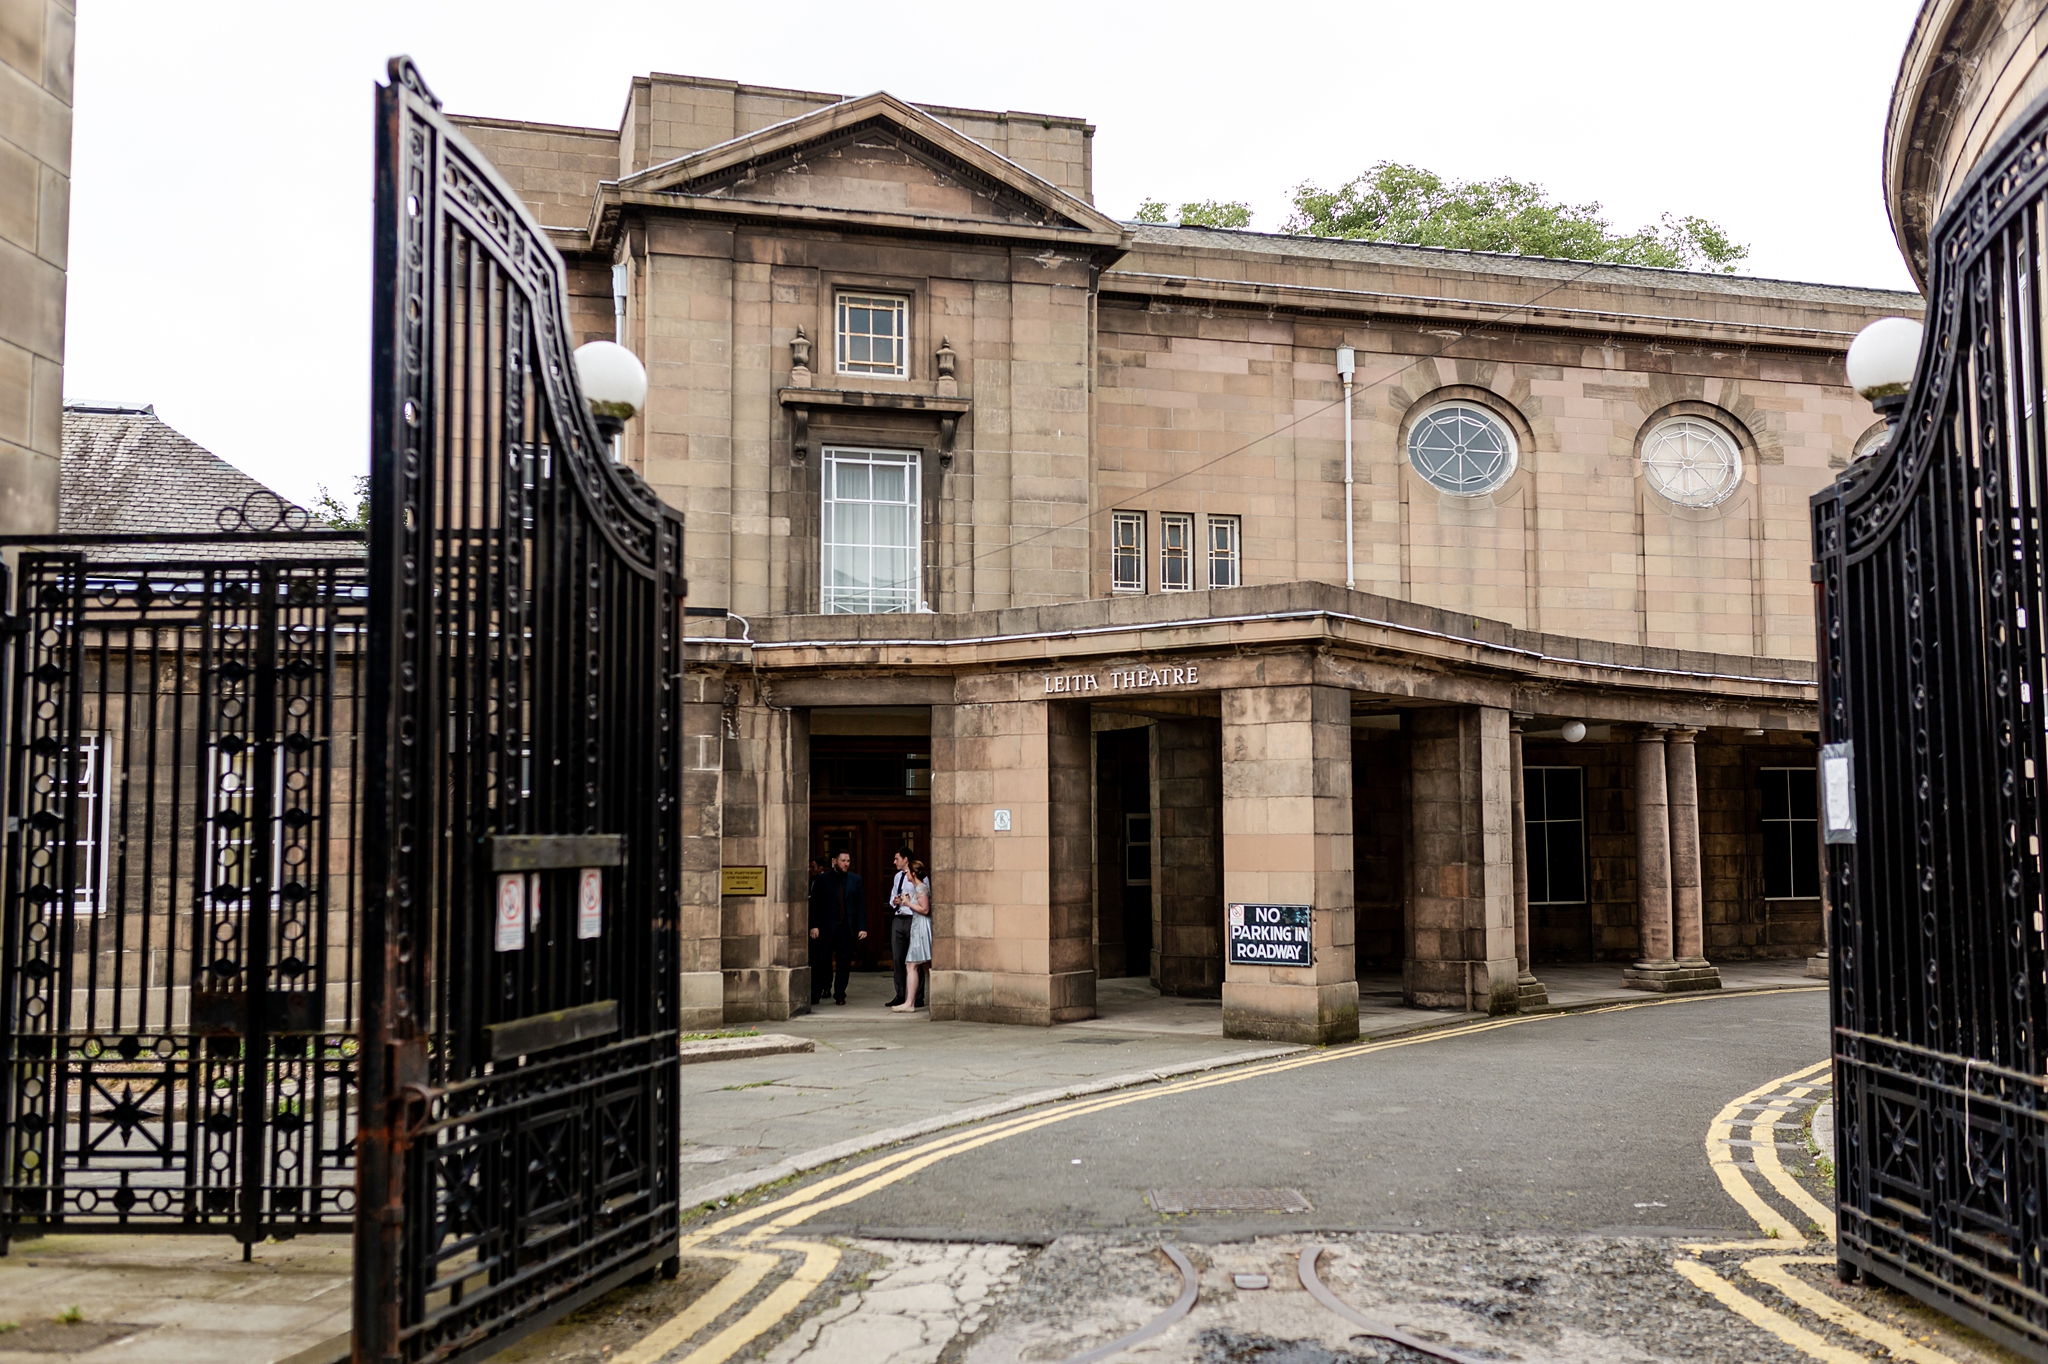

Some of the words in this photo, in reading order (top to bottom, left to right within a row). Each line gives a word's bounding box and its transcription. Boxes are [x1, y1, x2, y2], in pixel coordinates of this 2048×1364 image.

[1110, 667, 1199, 689] THEATRE
[1255, 907, 1281, 923] NO
[1231, 925, 1292, 941] PARKING
[1294, 926, 1308, 942] IN
[1237, 943, 1302, 960] ROADWAY
